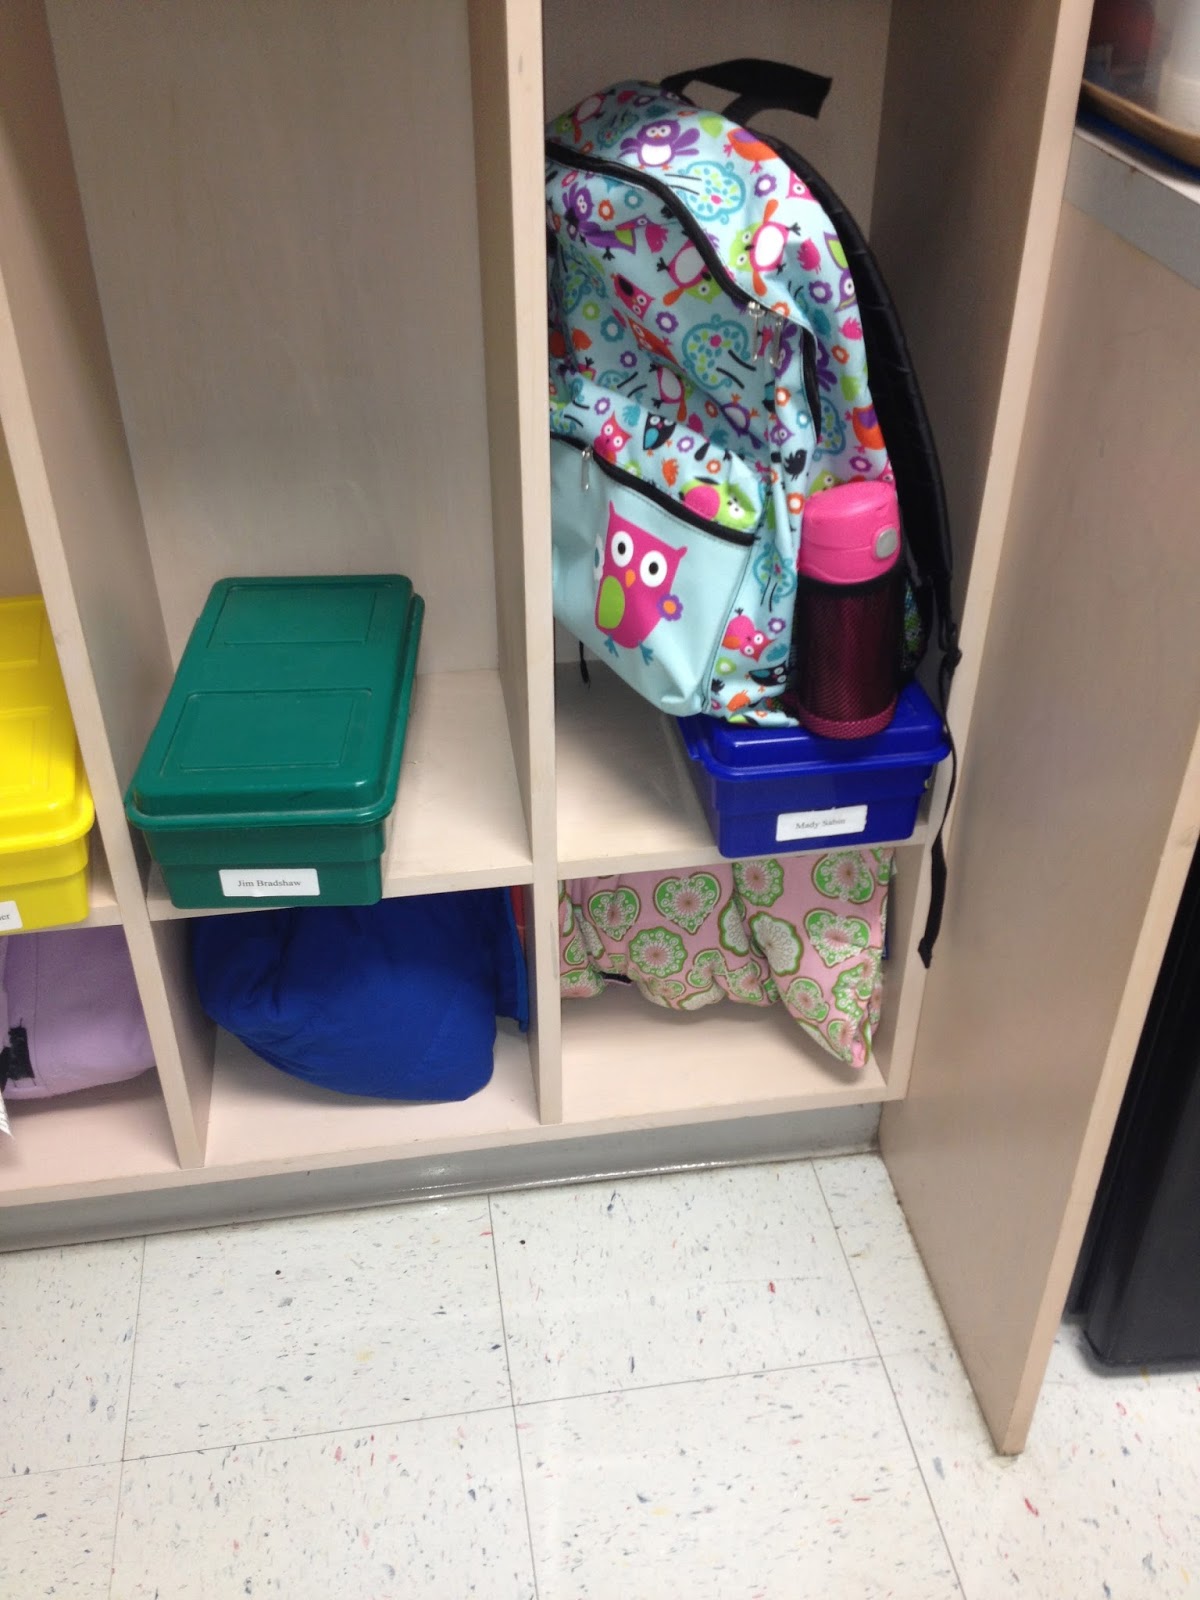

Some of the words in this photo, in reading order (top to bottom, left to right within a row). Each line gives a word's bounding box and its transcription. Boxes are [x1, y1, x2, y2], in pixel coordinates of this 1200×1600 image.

[795, 821, 819, 830] Mady
[237, 879, 254, 887] Jim
[256, 879, 301, 887] Bradshaw
